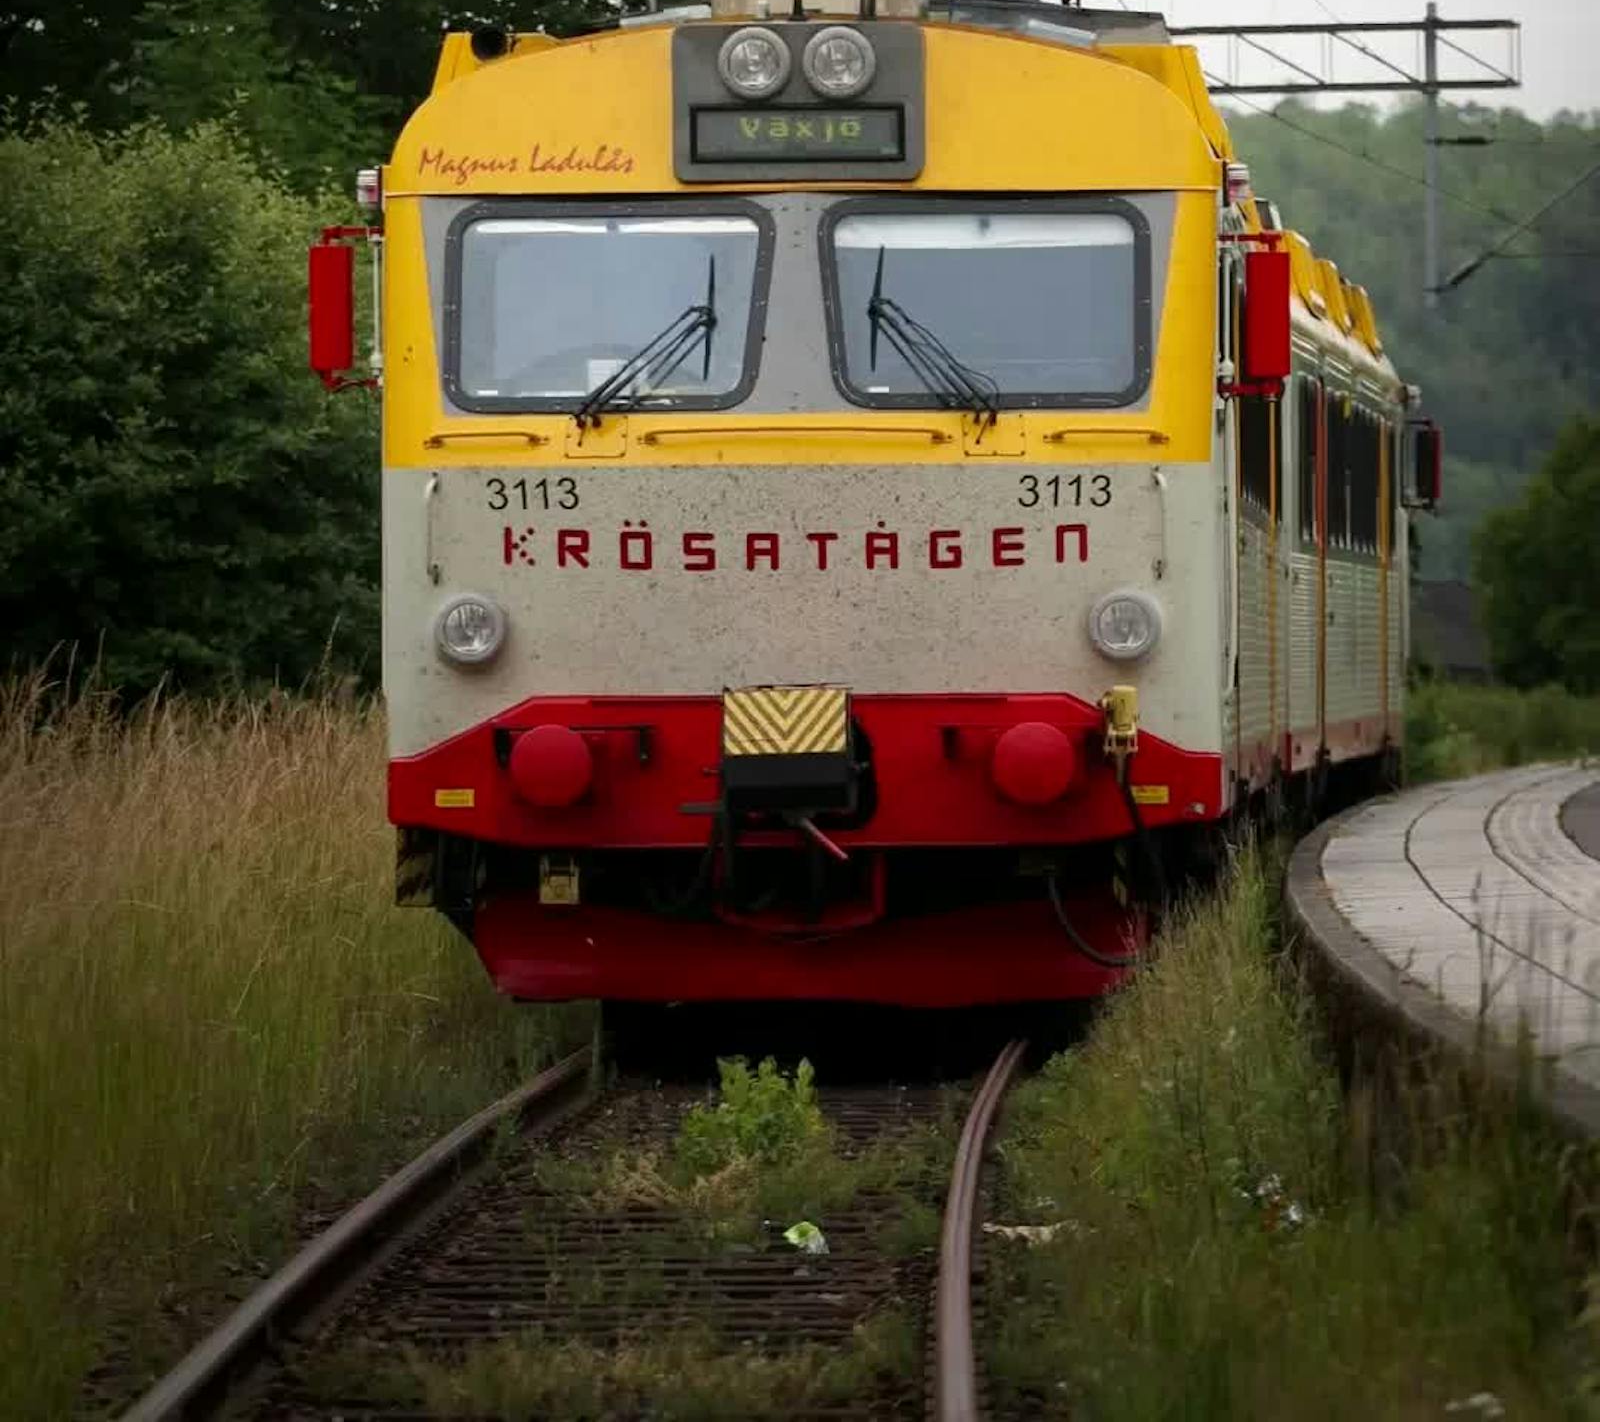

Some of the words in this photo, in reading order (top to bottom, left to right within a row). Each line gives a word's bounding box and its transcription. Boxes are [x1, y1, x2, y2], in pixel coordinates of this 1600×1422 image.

[418, 147, 518, 185] Magnus
[529, 143, 635, 175] Ladulås
[486, 477, 579, 510] 3113
[1018, 474, 1112, 508] 3113
